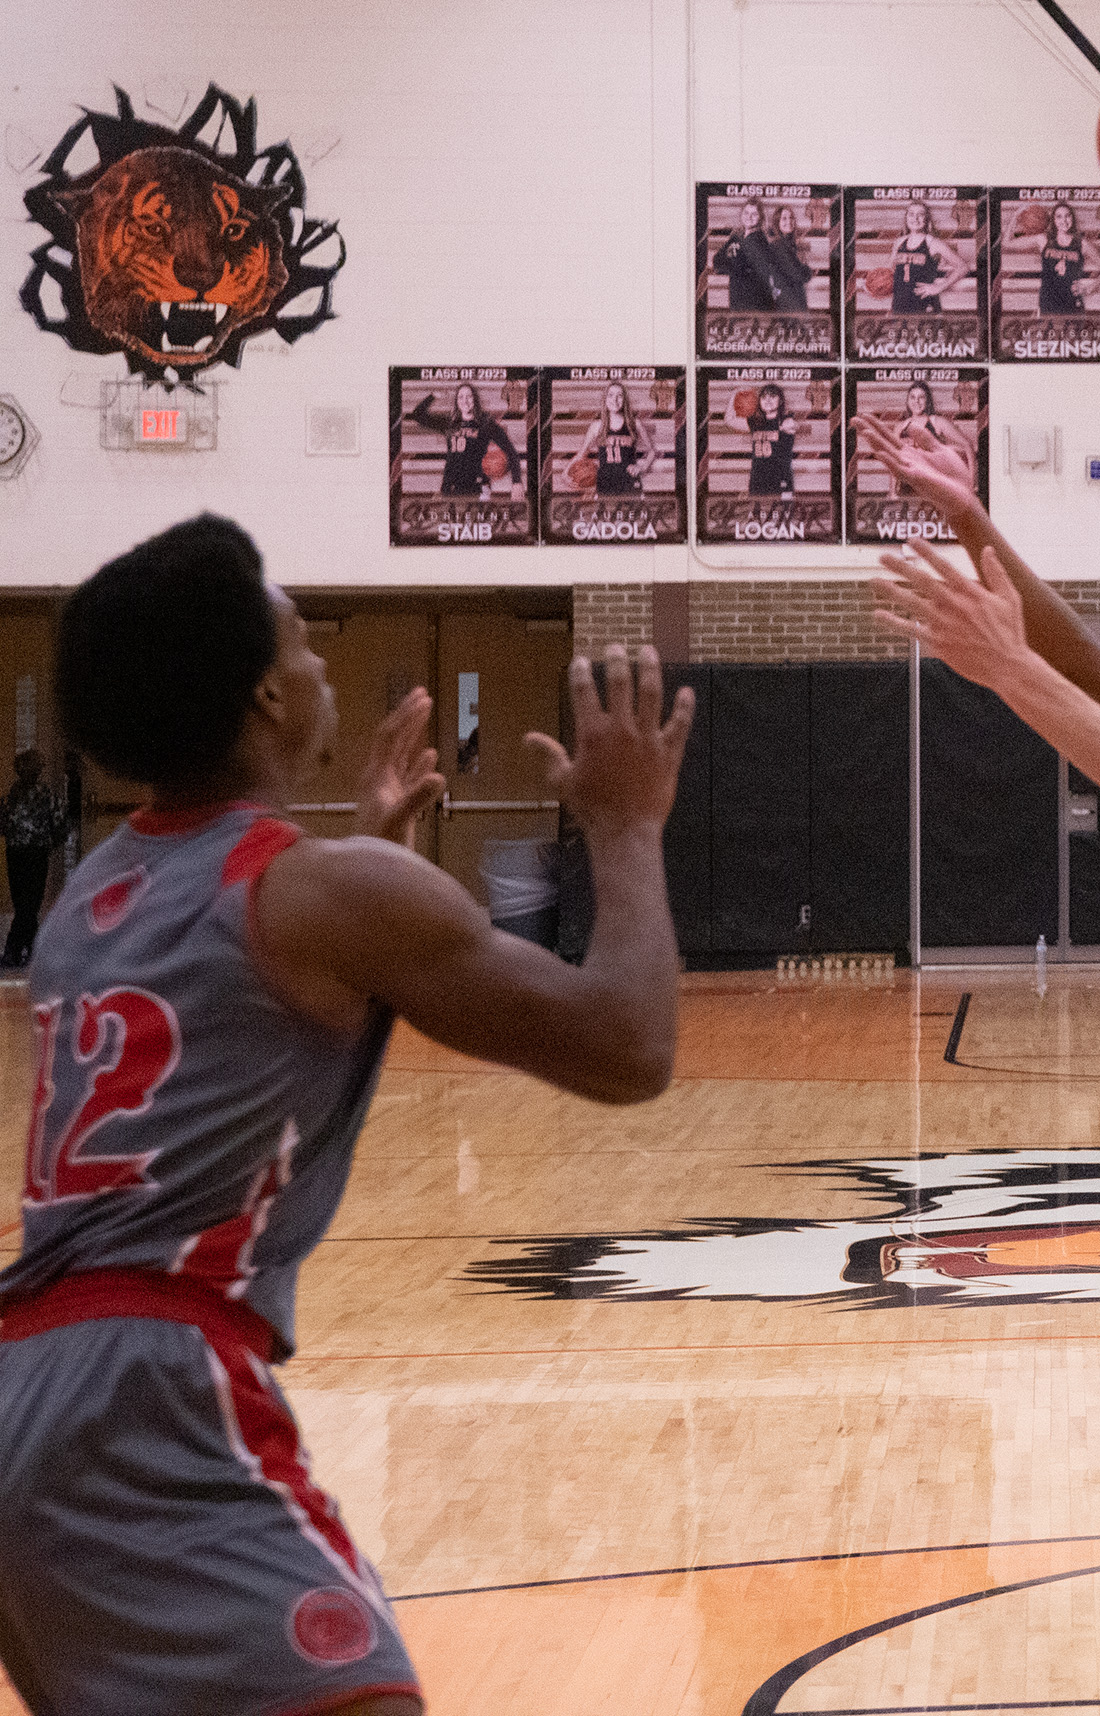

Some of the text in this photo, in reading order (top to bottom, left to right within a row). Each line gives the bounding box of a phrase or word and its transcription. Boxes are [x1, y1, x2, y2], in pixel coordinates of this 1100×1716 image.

[726, 185, 811, 197] CLASS OF 2023
[873, 188, 957, 199] CLASS OF 2023
[1018, 189, 1055, 199] CLASS
[1057, 189, 1071, 199] OF
[887, 329, 944, 338] GRACE
[858, 342, 976, 359] MACCAUGHAN
[420, 368, 507, 379] CLASS OF 2023
[570, 368, 656, 379] CLASS OF 2023
[727, 369, 812, 380] CLASS OF 2023
[875, 369, 959, 380] CLASS OF 2023
[142, 410, 181, 438] EXIT
[417, 511, 510, 521] ADRIENNE
[579, 510, 649, 520] LAUREN
[747, 510, 791, 519] ABBY
[882, 511, 946, 519] KEEGA
[437, 522, 493, 542] STAIB
[572, 522, 658, 540] GADOLA
[734, 522, 805, 540] LOGAN
[23, 985, 182, 1208] 12
